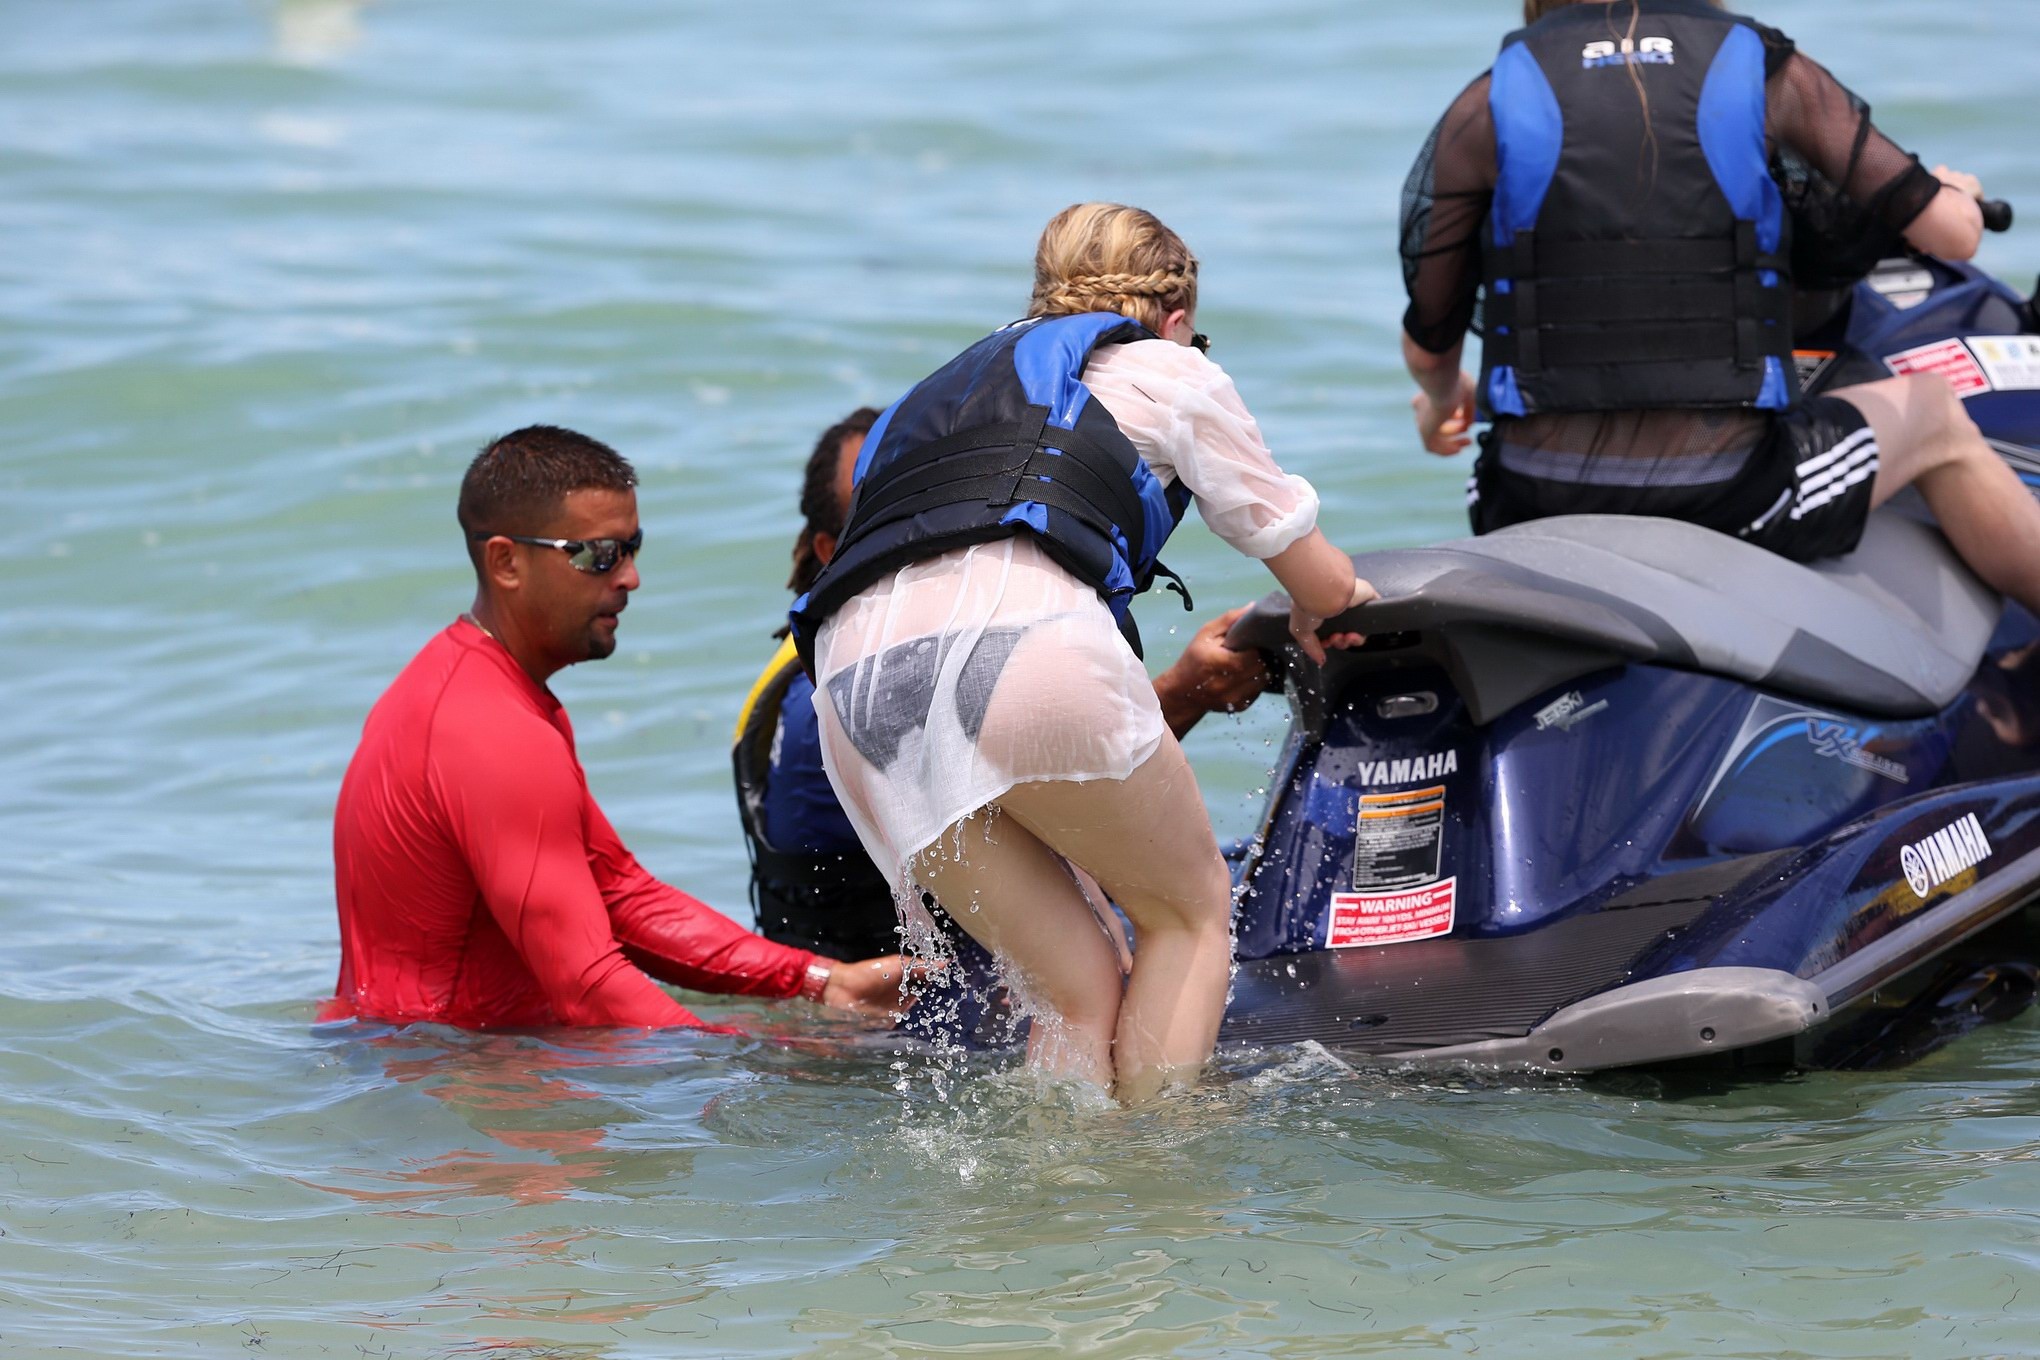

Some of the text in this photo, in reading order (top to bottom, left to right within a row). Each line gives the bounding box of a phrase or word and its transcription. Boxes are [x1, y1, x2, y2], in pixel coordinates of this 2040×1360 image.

[1358, 749, 1458, 786] YAMAHA
[1915, 811, 1993, 886] YAMAHA
[1360, 892, 1433, 914] WARNING
[1334, 926, 1359, 937] FROM
[1419, 912, 1450, 929] VESSELS
[1336, 916, 1356, 926] STAY
